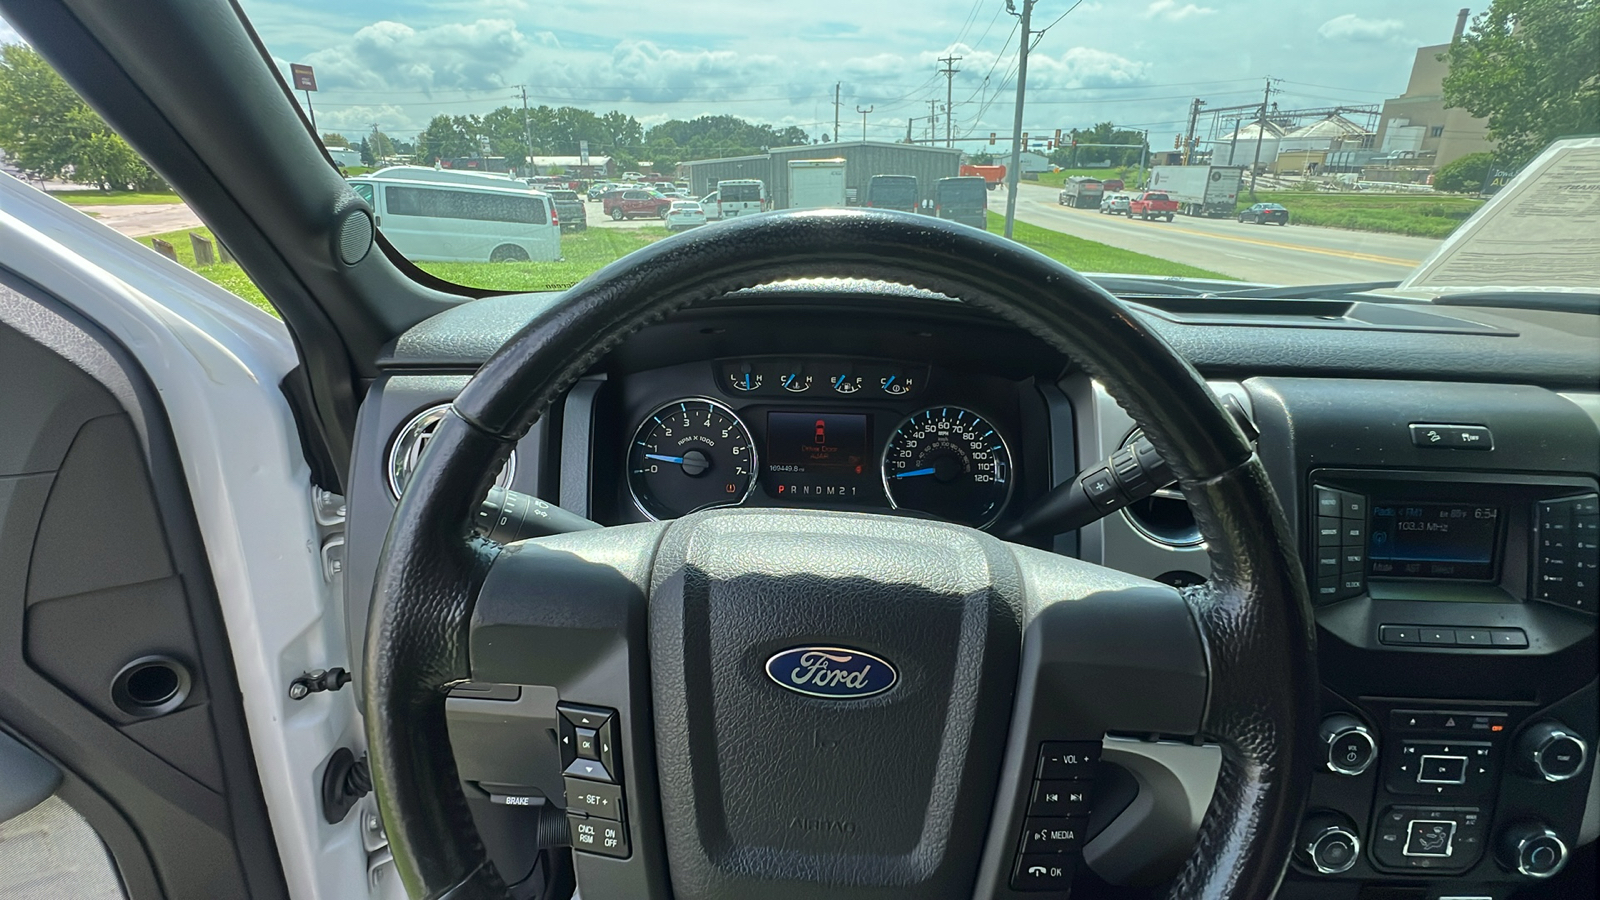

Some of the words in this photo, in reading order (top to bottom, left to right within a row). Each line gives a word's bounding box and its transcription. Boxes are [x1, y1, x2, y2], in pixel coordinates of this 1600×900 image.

[704, 419, 710, 427] 4
[678, 436, 692, 446] RPM
[700, 436, 714, 446] 1000
[1474, 508, 1497, 519] 6:54
[1398, 521, 1424, 531] 103.3
[791, 652, 871, 689] Ford
[1063, 755, 1078, 764] VOL
[506, 797, 529, 806] BRAKE
[586, 795, 600, 805] SET
[578, 824, 595, 835] CNCL
[605, 828, 615, 838] ON
[579, 834, 593, 844] RSM
[1050, 831, 1074, 840] MEDIA
[604, 838, 617, 848] OFF
[1050, 867, 1062, 877] OK
